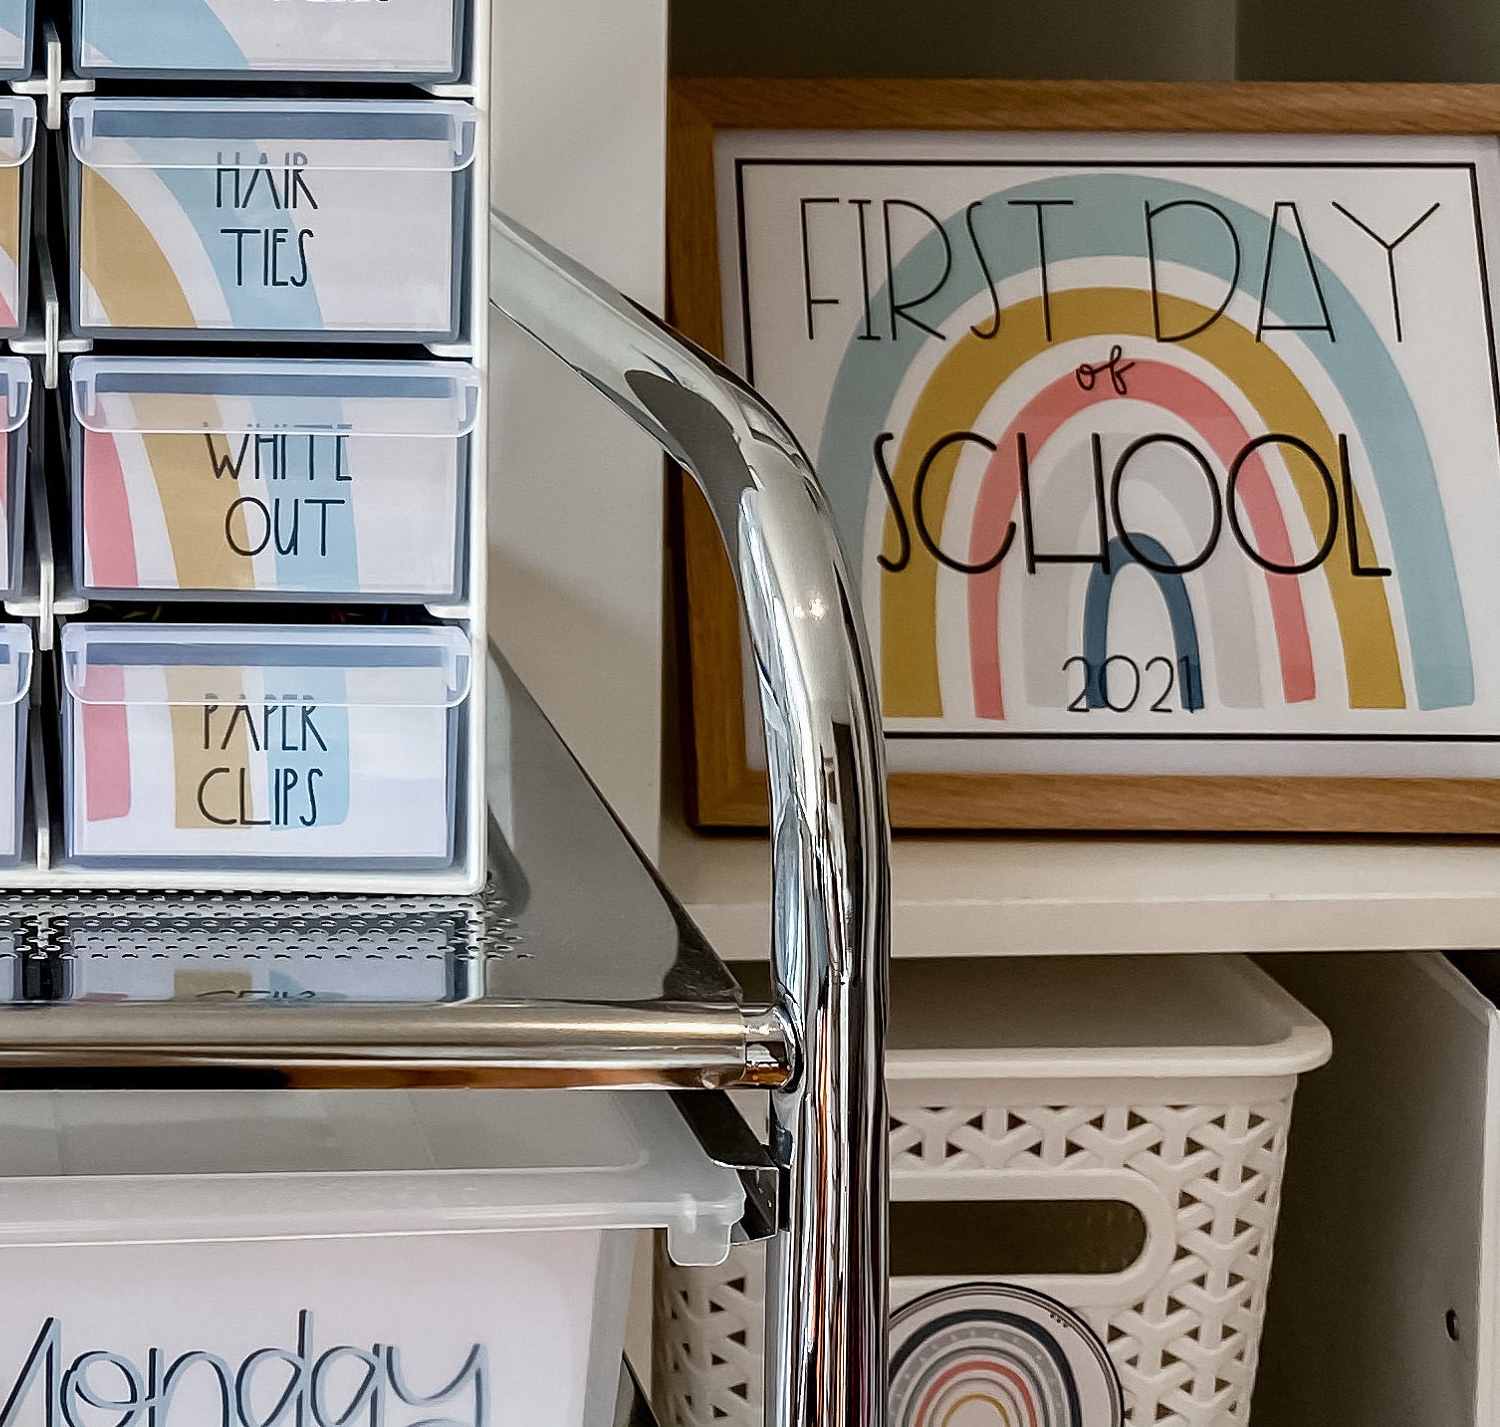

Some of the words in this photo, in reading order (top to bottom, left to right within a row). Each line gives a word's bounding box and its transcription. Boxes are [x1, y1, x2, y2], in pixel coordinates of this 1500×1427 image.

[216, 151, 319, 211] HAIR
[220, 228, 315, 288] TIES
[799, 197, 1074, 343] FIRST
[1143, 199, 1441, 343] DAY
[1075, 344, 1137, 396] of
[203, 423, 353, 482] WHITE
[225, 496, 346, 557] OUT
[873, 431, 1393, 577] SCHOOL
[1062, 655, 1198, 714] 2021
[203, 694, 329, 753] PAPER
[198, 767, 324, 827] CLIPS
